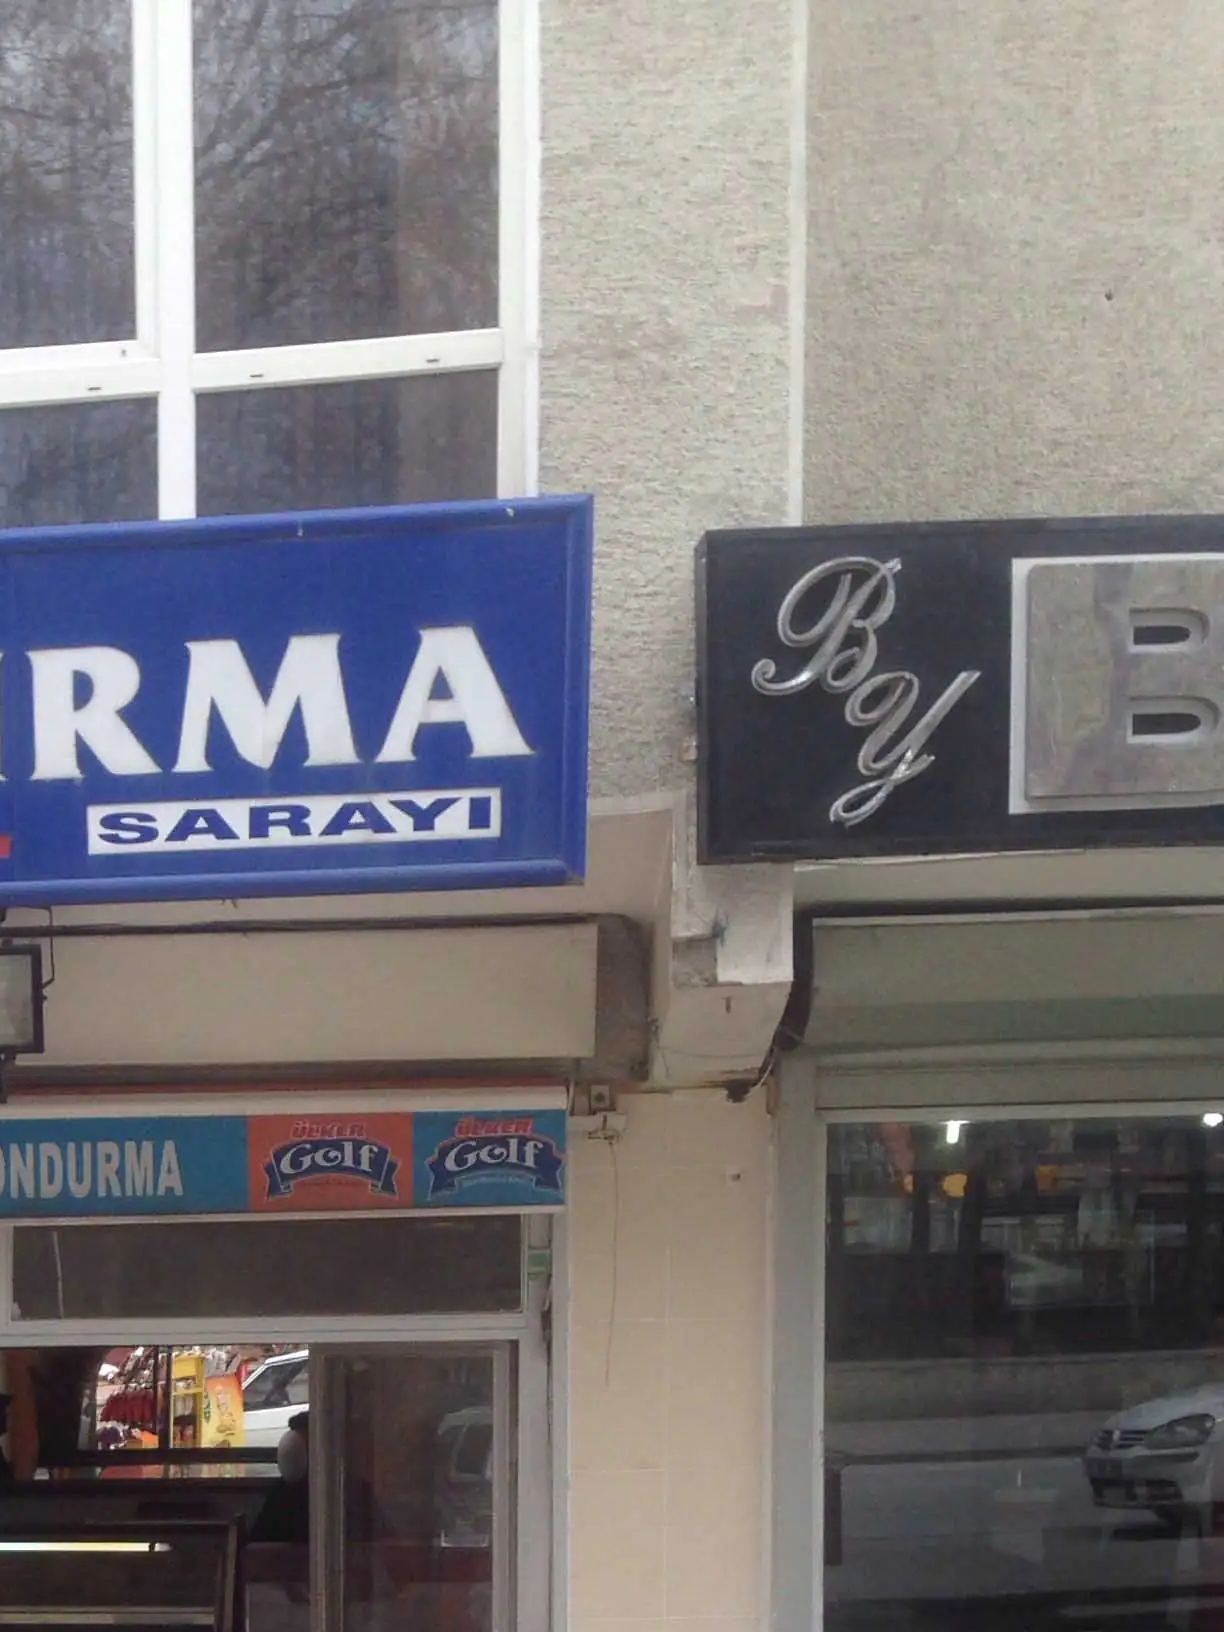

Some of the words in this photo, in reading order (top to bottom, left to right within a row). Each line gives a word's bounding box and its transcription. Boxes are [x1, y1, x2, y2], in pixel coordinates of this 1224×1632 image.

[98, 792, 494, 847] SARAYI
[290, 1119, 367, 1139] ÜLKER
[454, 1115, 534, 1137] ÜLKER
[280, 1140, 380, 1175] Golf
[444, 1137, 543, 1173] Golf
